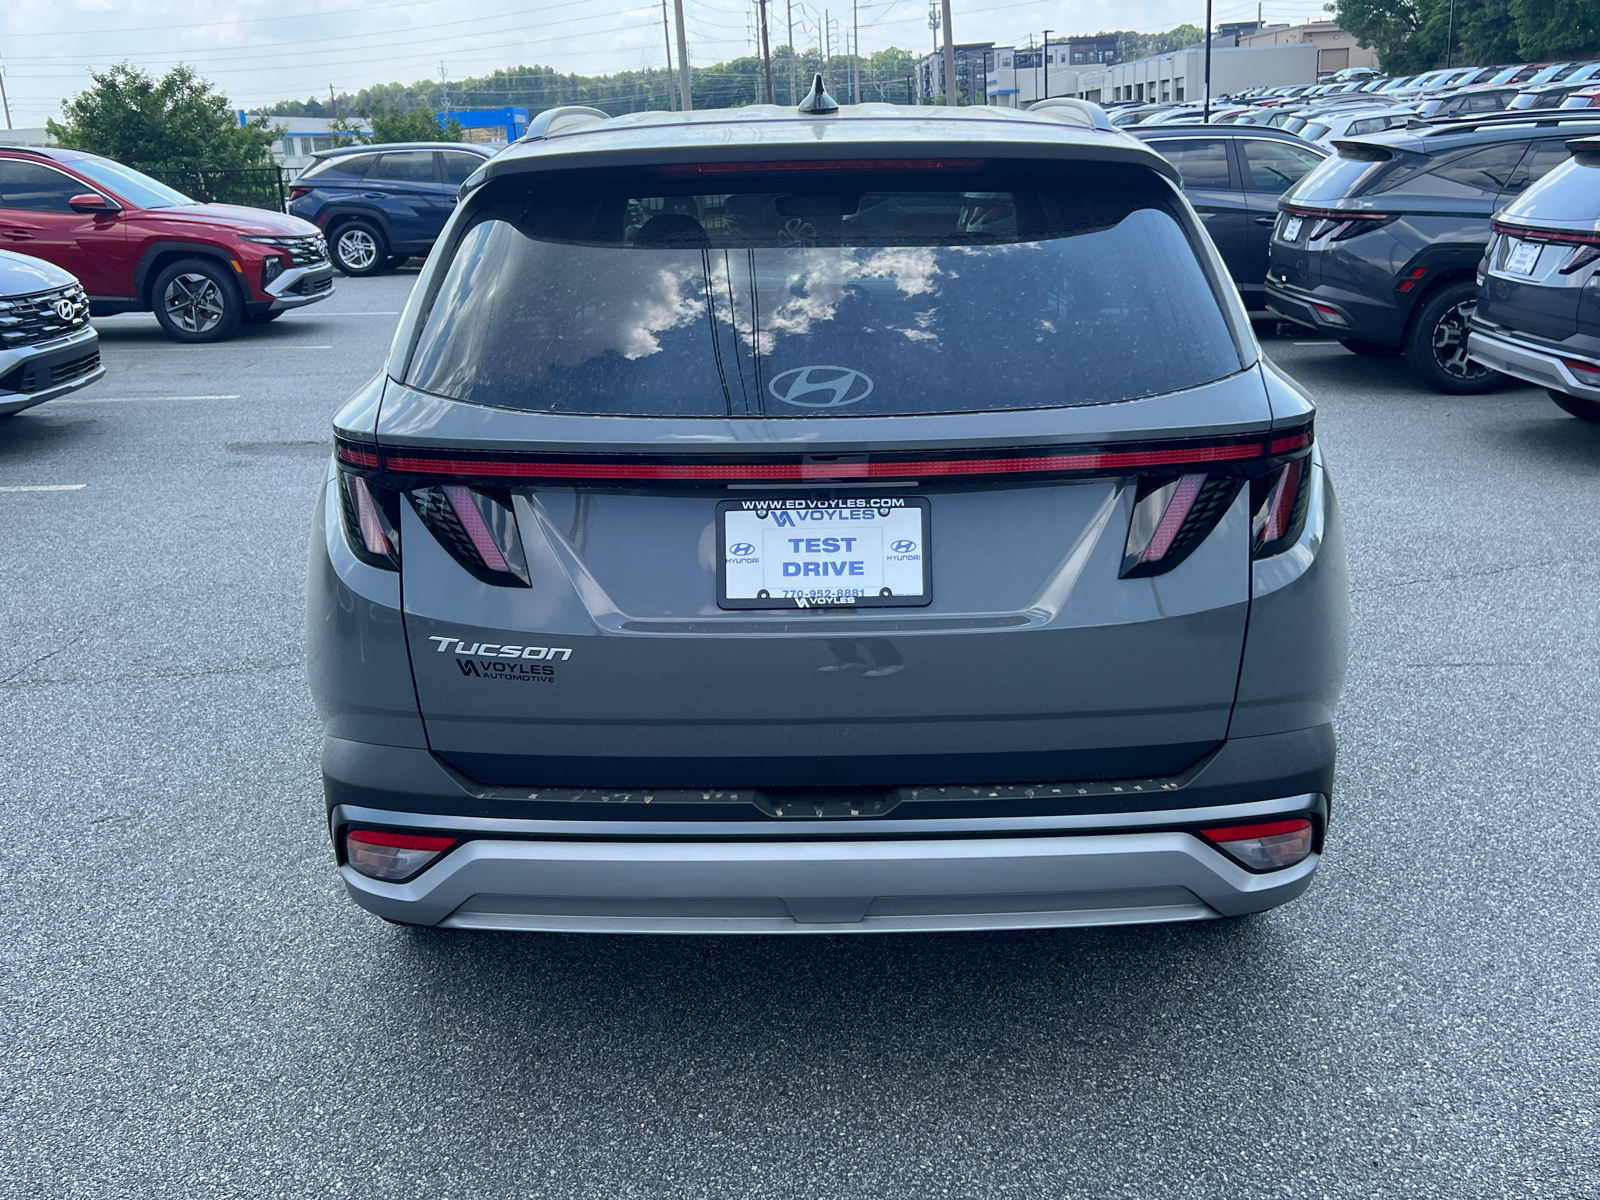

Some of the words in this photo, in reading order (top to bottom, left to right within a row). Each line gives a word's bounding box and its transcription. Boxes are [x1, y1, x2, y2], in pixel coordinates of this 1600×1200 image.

[795, 509, 875, 521] VOYLES
[788, 537, 857, 553] TEST
[782, 560, 865, 577] DRIVE
[782, 588, 865, 598] 770-952-8881
[809, 597, 855, 605] VOYLES
[480, 660, 555, 676] VOYLES
[482, 672, 555, 683] AUTOMOTIVE
